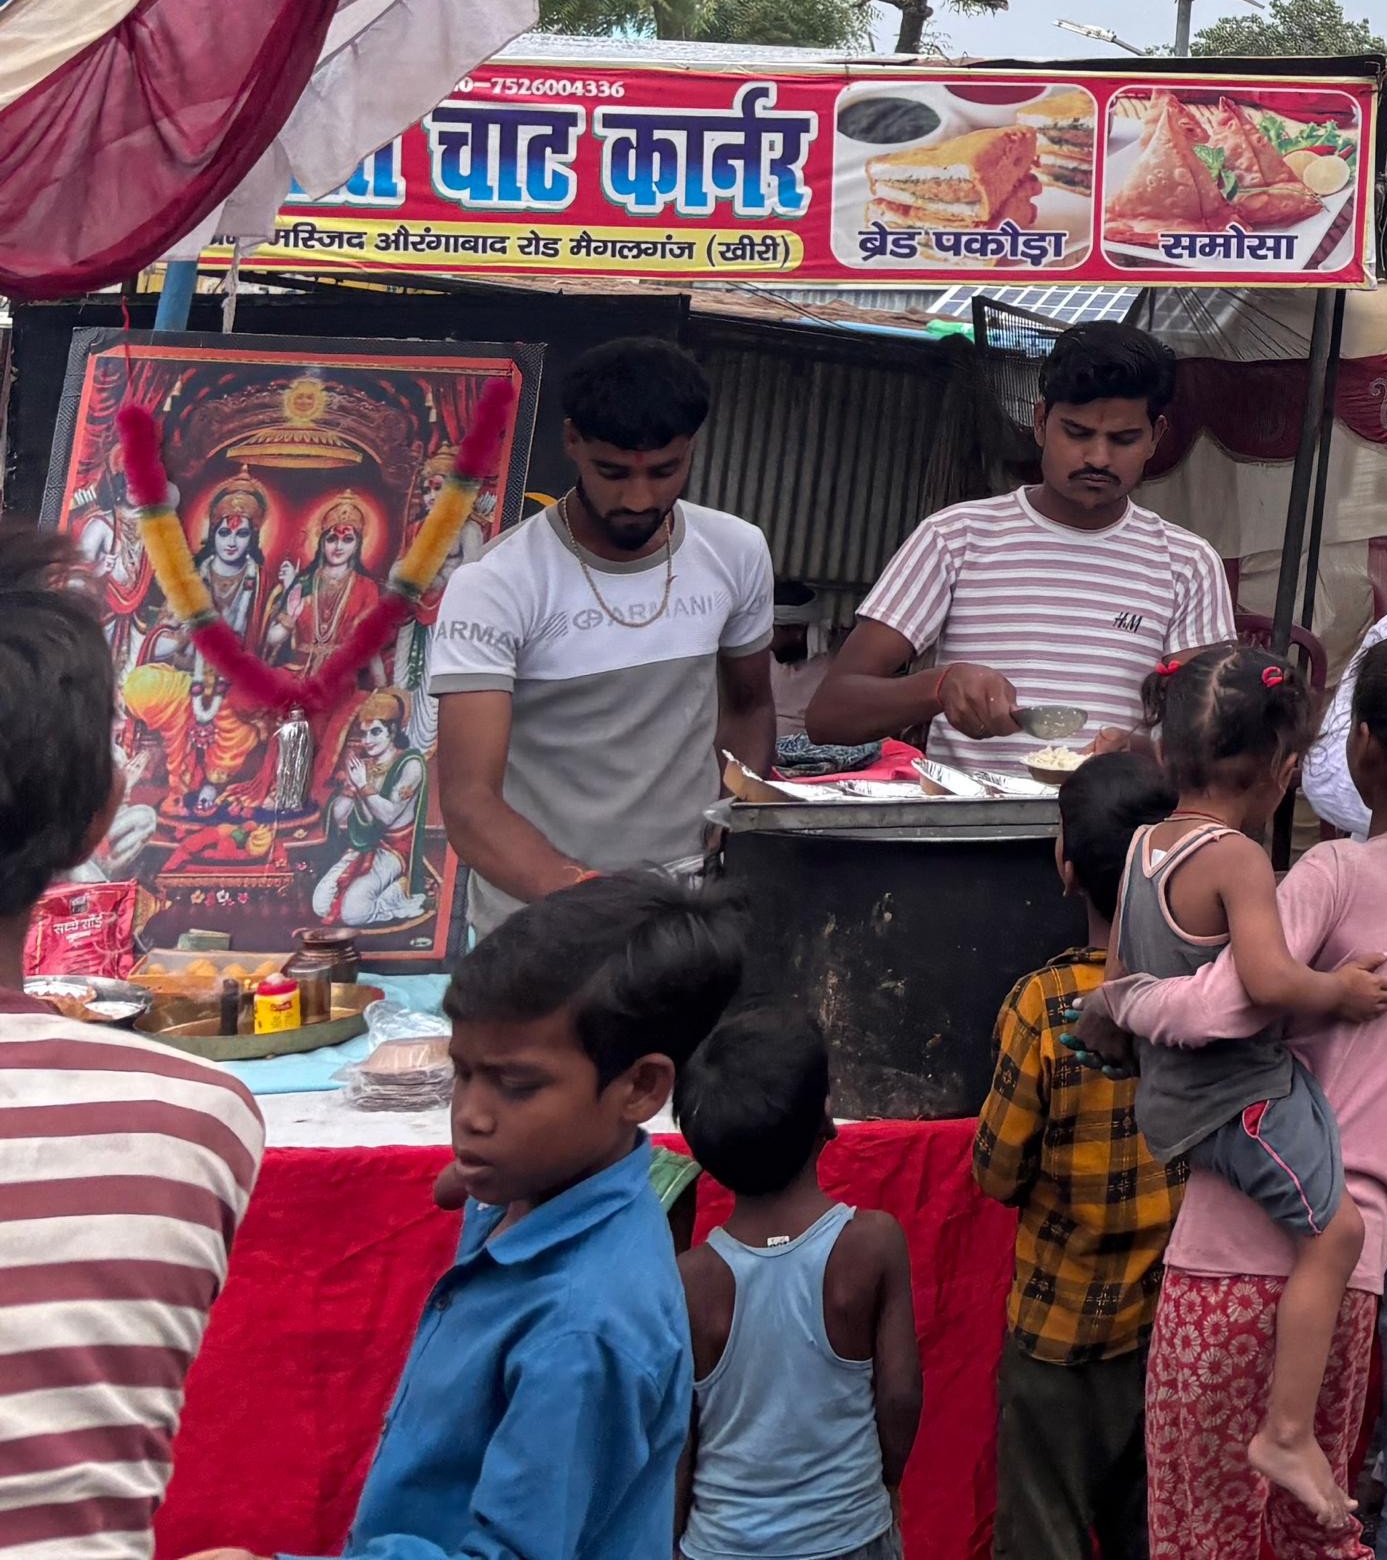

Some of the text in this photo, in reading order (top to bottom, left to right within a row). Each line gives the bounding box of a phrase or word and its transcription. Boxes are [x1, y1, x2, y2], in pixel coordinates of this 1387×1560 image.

[430, 105, 584, 208] चाट
[374, 225, 510, 254] औरंगाबाद
[517, 230, 562, 258] रोड
[569, 230, 697, 260] मैगलगंज
[706, 234, 791, 267] (खीरी)
[857, 221, 1067, 268] ब्रेड पकौड़ा
[1159, 223, 1298, 261] समोसा
